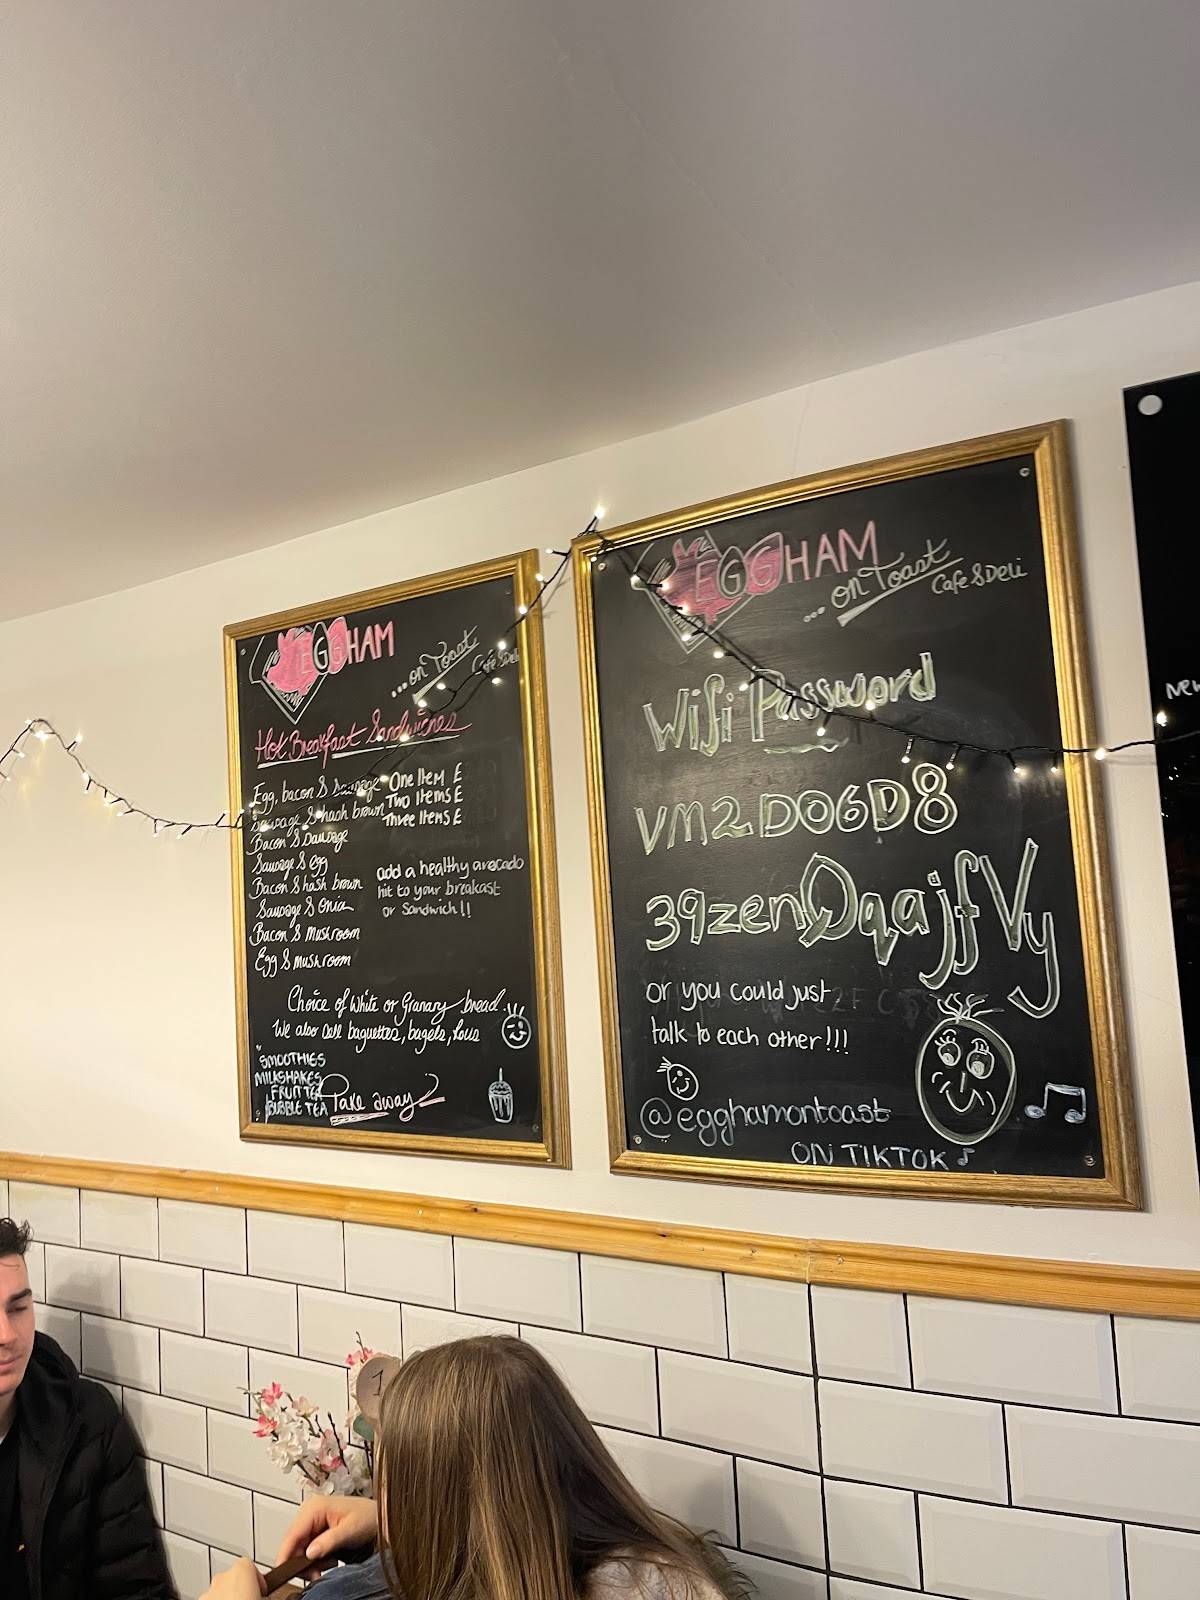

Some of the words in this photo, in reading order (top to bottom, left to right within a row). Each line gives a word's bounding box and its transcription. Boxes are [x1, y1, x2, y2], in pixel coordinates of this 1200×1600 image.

[694, 520, 880, 602] EGGHAM
[859, 538, 951, 592] Toast
[301, 616, 394, 675] EGGHAM
[419, 625, 478, 673] Toast
[750, 652, 937, 743] Password
[255, 728, 288, 762] Hot
[288, 722, 368, 769] Breakfast
[389, 771, 415, 792] One
[252, 782, 278, 815] Egg,
[281, 780, 315, 803] bacon
[320, 803, 348, 823] hash
[352, 800, 385, 820] brown
[385, 792, 411, 809] Two
[382, 812, 416, 827] Three
[246, 832, 287, 856] Bacon
[251, 852, 295, 881] Sausage
[376, 863, 401, 881] add
[404, 866, 417, 879] a
[419, 855, 470, 880] healthy
[248, 876, 289, 900] Bacon
[302, 874, 328, 893] hash
[331, 872, 364, 891] brown
[377, 883, 394, 900] hit
[396, 889, 411, 898] to
[413, 888, 442, 901] your
[255, 898, 302, 929] Sausage
[382, 905, 396, 918] or
[248, 921, 288, 947] Bacon
[254, 945, 278, 978] Egg
[287, 984, 329, 1013] Choice
[334, 987, 350, 1019] of
[382, 998, 400, 1012] or
[394, 991, 456, 1026] Granary
[645, 981, 673, 1004] or
[681, 980, 722, 1012] you
[729, 978, 784, 1003] could
[271, 1018, 292, 1039] We
[295, 1021, 320, 1038] also
[650, 1015, 689, 1045] talk
[696, 1021, 712, 1043] to
[716, 1027, 760, 1048] each
[258, 1052, 327, 1069] SMOOTHIES
[254, 1070, 323, 1088] MILKSHAKES
[264, 1099, 303, 1118] BUBBLE
[305, 1101, 329, 1118] TEA
[320, 1072, 367, 1113] Take
[371, 1072, 440, 1123] away
[640, 1096, 893, 1147] @egghamontoast
[790, 1142, 834, 1166] ON
[371, 1369, 384, 1396] 1
